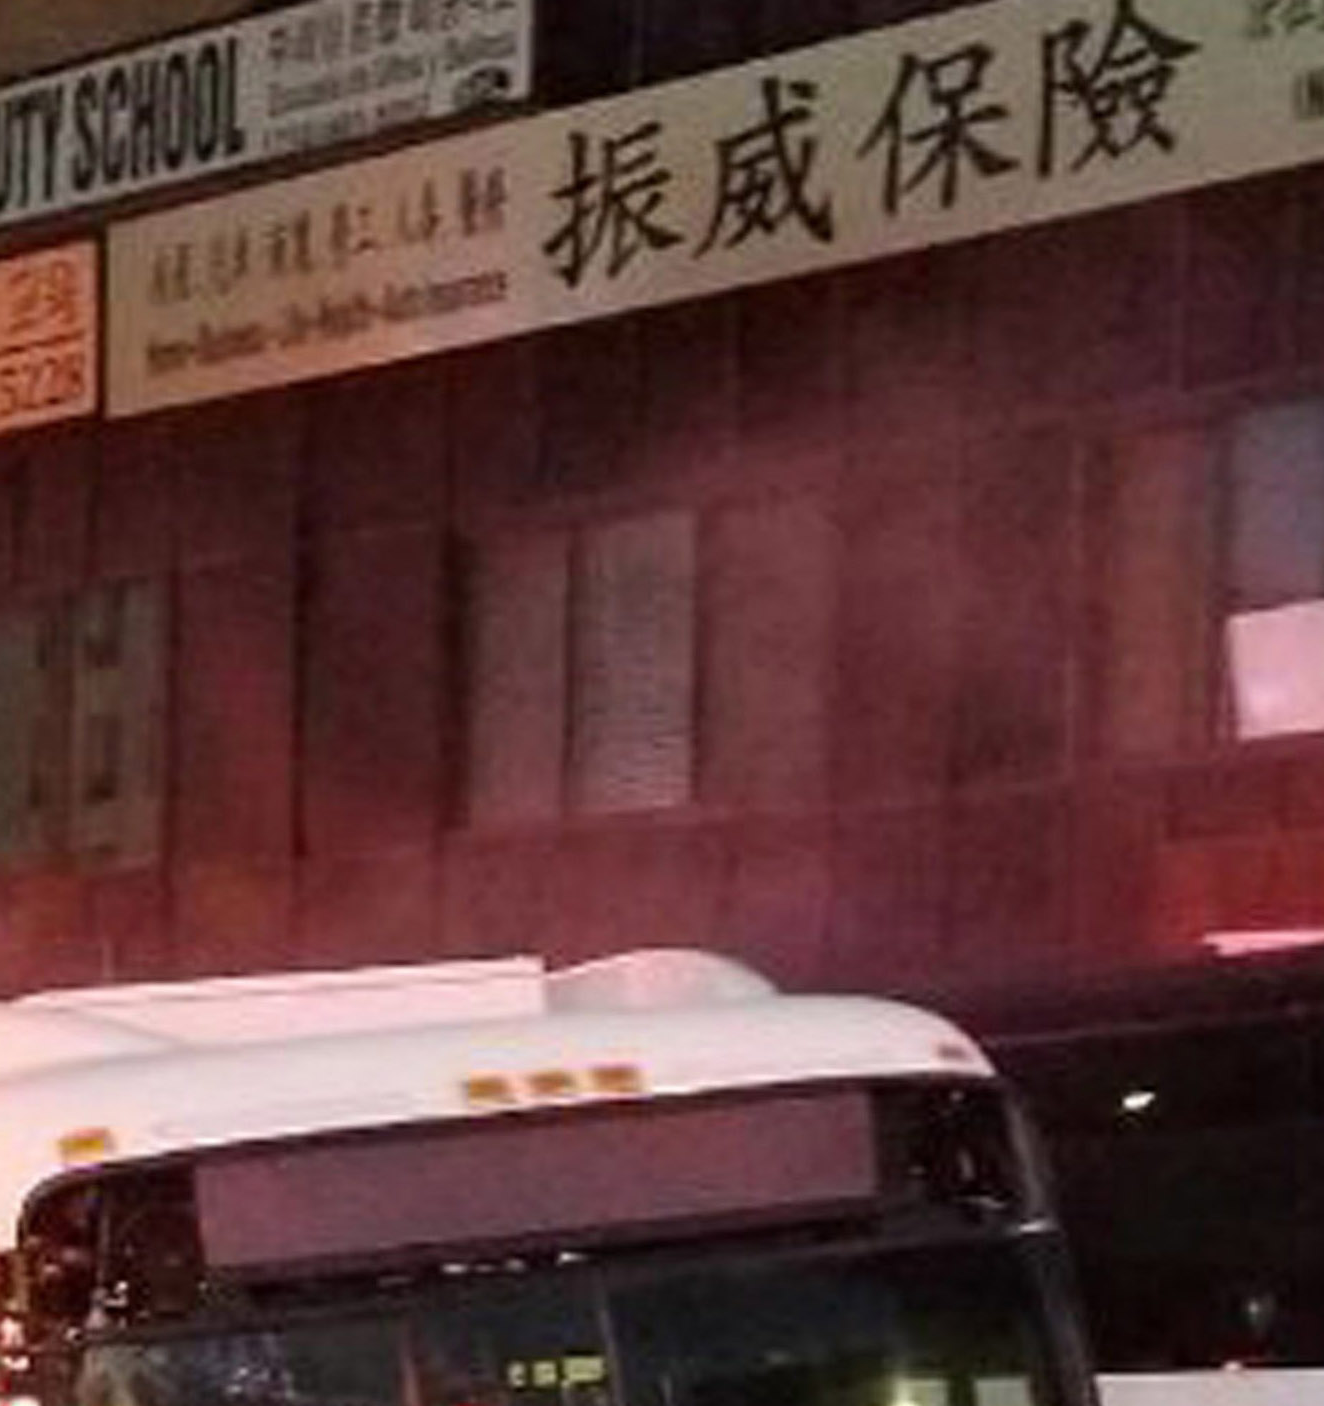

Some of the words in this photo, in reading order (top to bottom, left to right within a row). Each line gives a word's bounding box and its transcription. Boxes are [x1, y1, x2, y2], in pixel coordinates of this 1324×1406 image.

[72, 36, 244, 192] SCHOOL
[542, 0, 1200, 288] 振威保險
